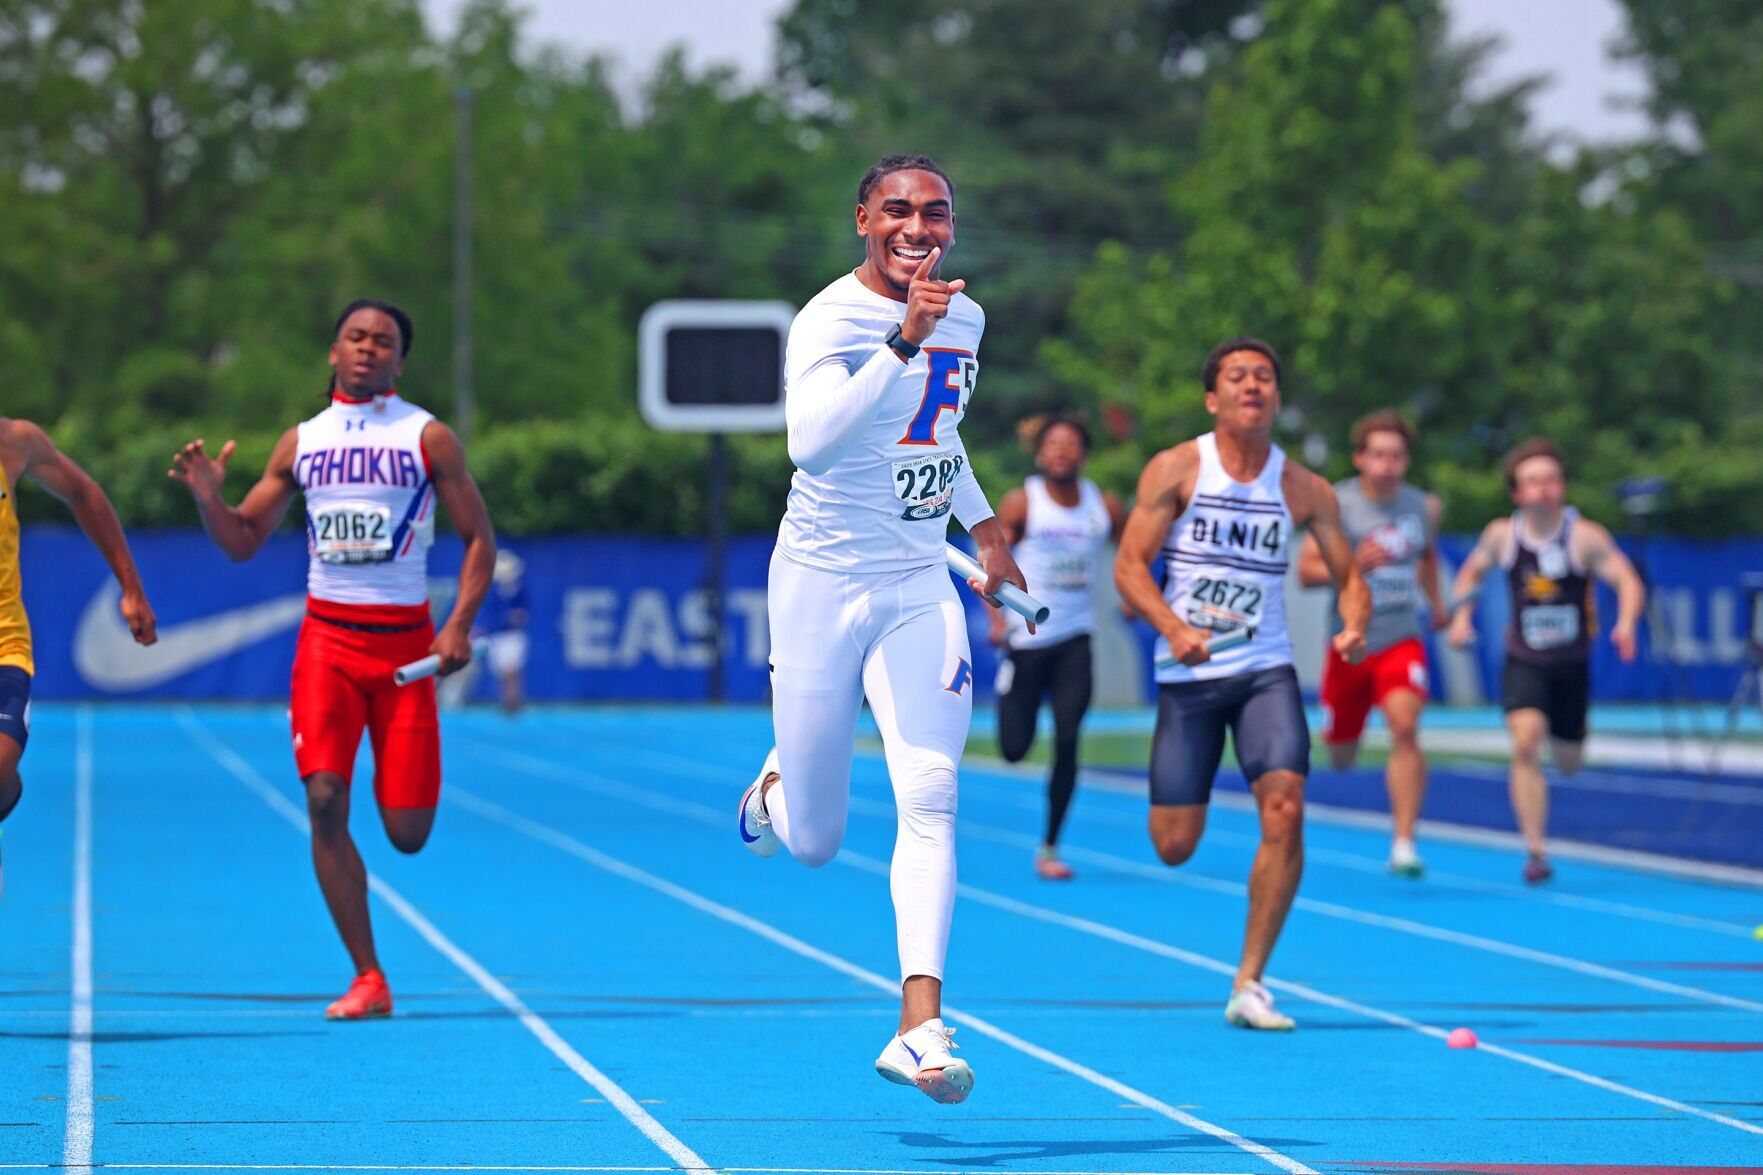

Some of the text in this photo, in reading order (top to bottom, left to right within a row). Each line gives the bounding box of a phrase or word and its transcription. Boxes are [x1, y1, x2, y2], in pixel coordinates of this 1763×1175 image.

[896, 347, 974, 445] F
[297, 447, 418, 490] CAHOKIA
[318, 512, 385, 541] 2062
[1191, 577, 1263, 616] 2672
[562, 587, 769, 670] EAST
[944, 656, 972, 696] F
